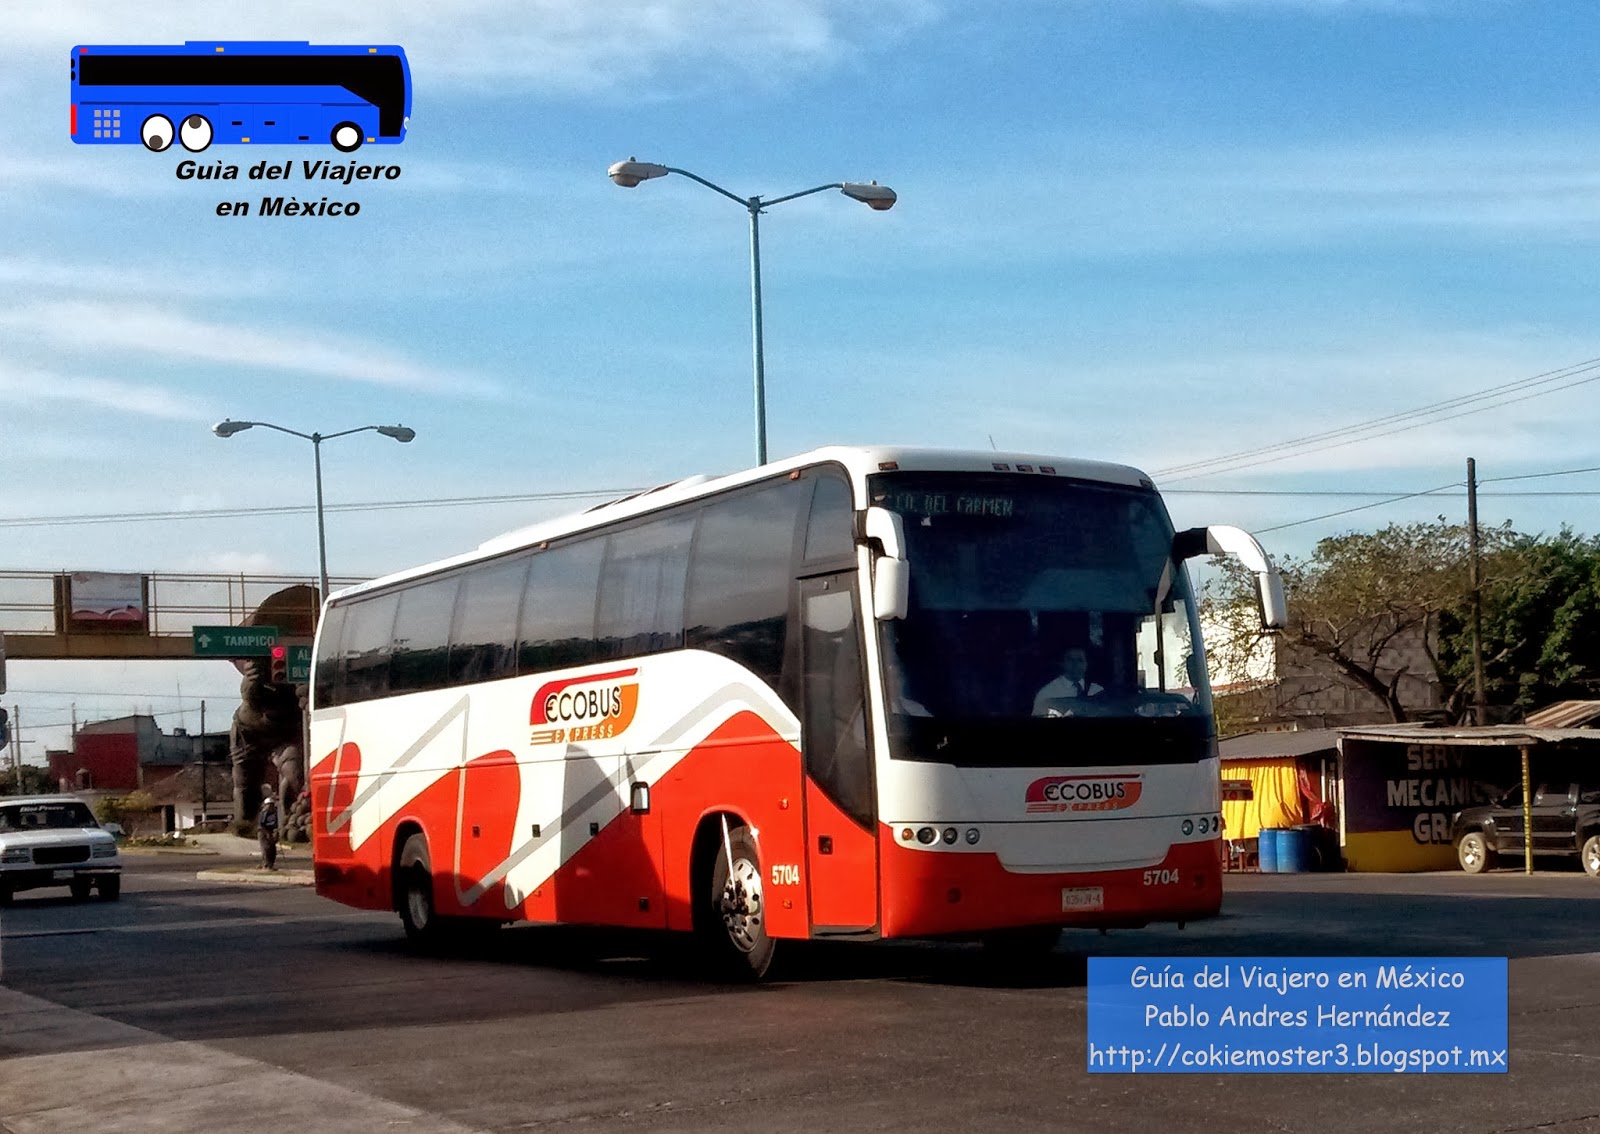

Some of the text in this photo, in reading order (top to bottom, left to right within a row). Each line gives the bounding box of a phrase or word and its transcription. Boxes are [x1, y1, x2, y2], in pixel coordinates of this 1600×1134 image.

[925, 494, 949, 513] DEL
[956, 495, 1014, 517] CARMEN
[223, 634, 275, 647] TAMPICO
[292, 666, 310, 678] BLV
[545, 686, 621, 723] ECOBUS
[554, 723, 614, 745] EXPRESS
[1044, 781, 1126, 801] ECOBUS
[1056, 802, 1119, 812] EXPRESS
[771, 864, 801, 886] 5704
[1143, 868, 1180, 886] 5704
